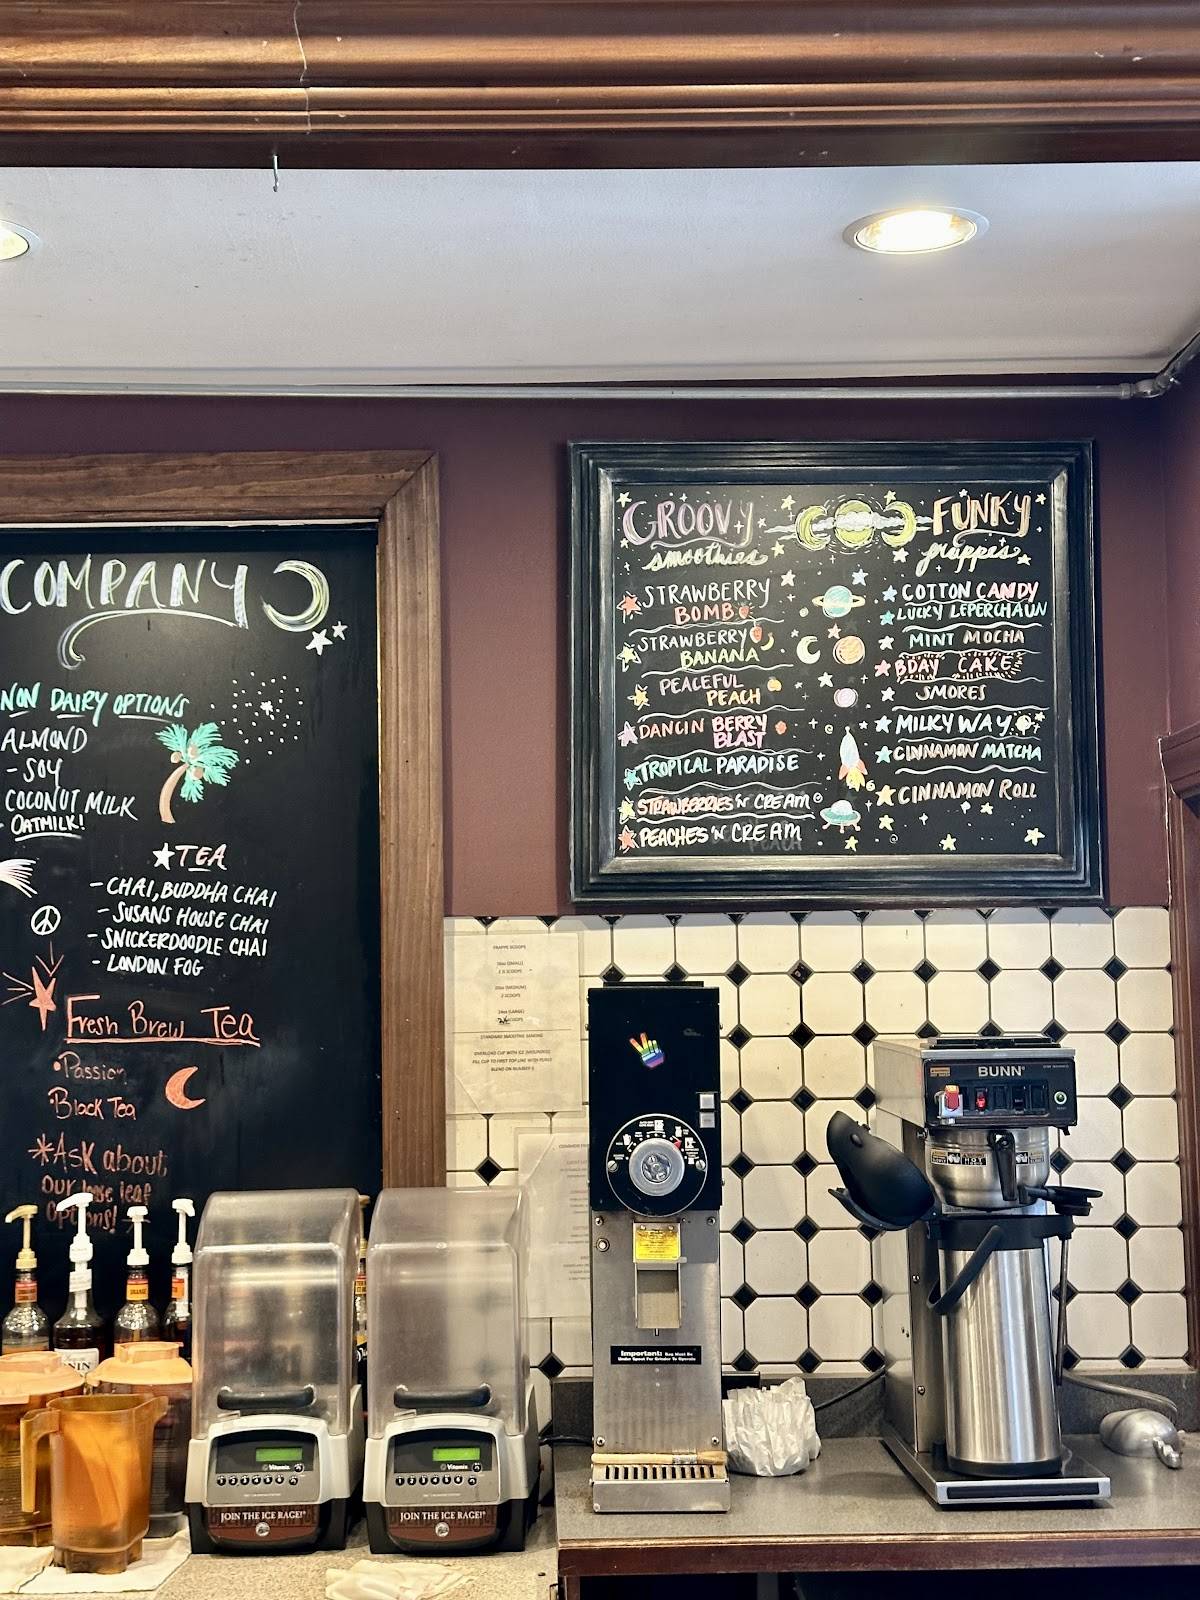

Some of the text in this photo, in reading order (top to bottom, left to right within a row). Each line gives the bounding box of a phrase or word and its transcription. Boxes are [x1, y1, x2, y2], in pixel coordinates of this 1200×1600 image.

[622, 500, 753, 548] GROOVY
[932, 491, 1032, 542] FUNKY
[642, 542, 768, 571] smoothies
[0, 554, 248, 630] COMPANY
[643, 578, 771, 608] STRAWBERRY
[902, 581, 1039, 602] COTTON CANDY
[674, 603, 735, 625] BOMB
[896, 602, 1047, 620] LUCKY LEPERCHAUN
[638, 628, 747, 652] STRAWBERRY
[909, 630, 1025, 648] MINT MOCHA
[680, 648, 760, 668] BANANA
[895, 655, 1013, 678] BDAY CAKE
[659, 673, 744, 696] PEACEFUL
[916, 684, 986, 701] SMORES
[0, 682, 190, 727] NON DAIRY OPTIONS
[706, 688, 761, 706] PEACH
[712, 714, 767, 732] BERRY
[896, 713, 1013, 736] MILKY WAY
[1, 726, 88, 754] ALMOND
[713, 731, 767, 749] BLAST
[893, 742, 1042, 761] CINNAMON MATCHA
[23, 758, 64, 788] SOY
[636, 754, 799, 783] TROPICAL PARADISE
[899, 779, 1038, 804] CINNAMON ROLL
[5, 788, 139, 821] COCONUT MILK
[637, 795, 734, 816] STRAWBERRIES
[753, 792, 811, 810] CREAM
[11, 814, 86, 835] OATMILK!
[639, 826, 709, 848] PEACHES
[731, 823, 802, 842] CREAM
[175, 843, 228, 870] TEA
[232, 886, 278, 907] CHAI
[112, 902, 270, 934] SUSANS HOUSE CHAI
[101, 928, 268, 957] SNICKERDOODLE CHAI
[107, 954, 204, 977] LONDON FOG
[66, 994, 260, 1041] Fresh Brew Tea
[58, 1051, 127, 1080] Passion
[48, 1086, 136, 1120] Black Tea
[103, 1144, 168, 1177] about
[41, 1174, 77, 1197] Our
[46, 1203, 117, 1234] Optons!
[220, 1512, 241, 1523] JOIN
[243, 1511, 260, 1520] THE
[261, 1511, 276, 1519] ICE
[400, 1512, 420, 1522] JOIN
[422, 1511, 439, 1520] THE
[441, 1511, 456, 1519] ICE
